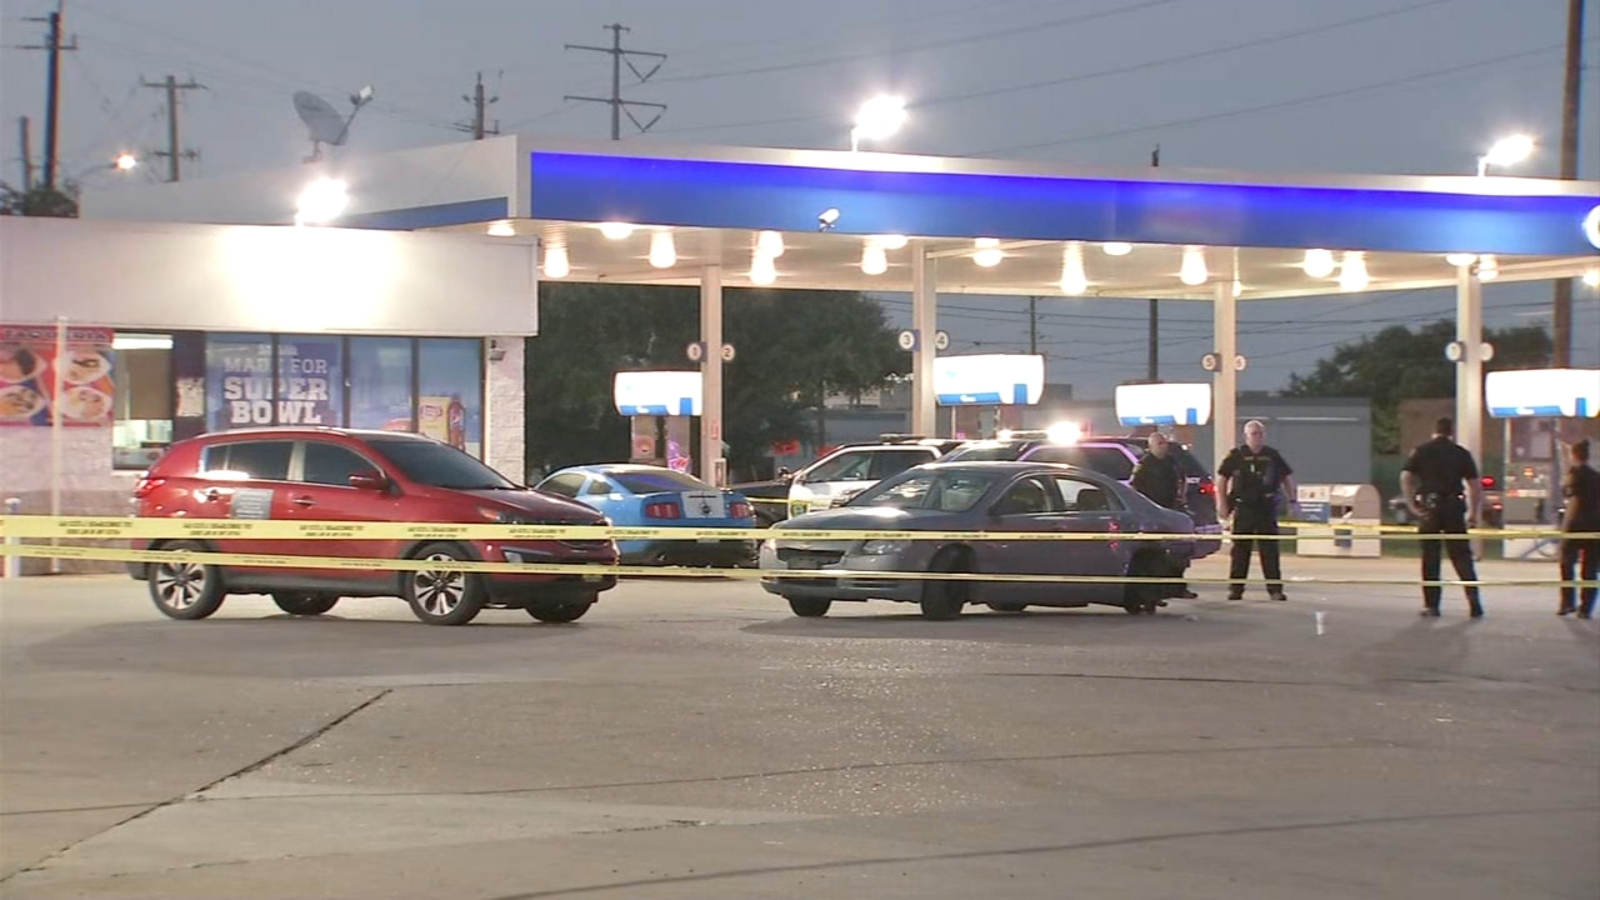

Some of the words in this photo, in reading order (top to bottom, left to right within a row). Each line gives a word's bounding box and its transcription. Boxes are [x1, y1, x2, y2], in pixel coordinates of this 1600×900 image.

[291, 358, 328, 374] FOR
[224, 376, 328, 401] SUPER
[230, 400, 322, 424] BOWL
